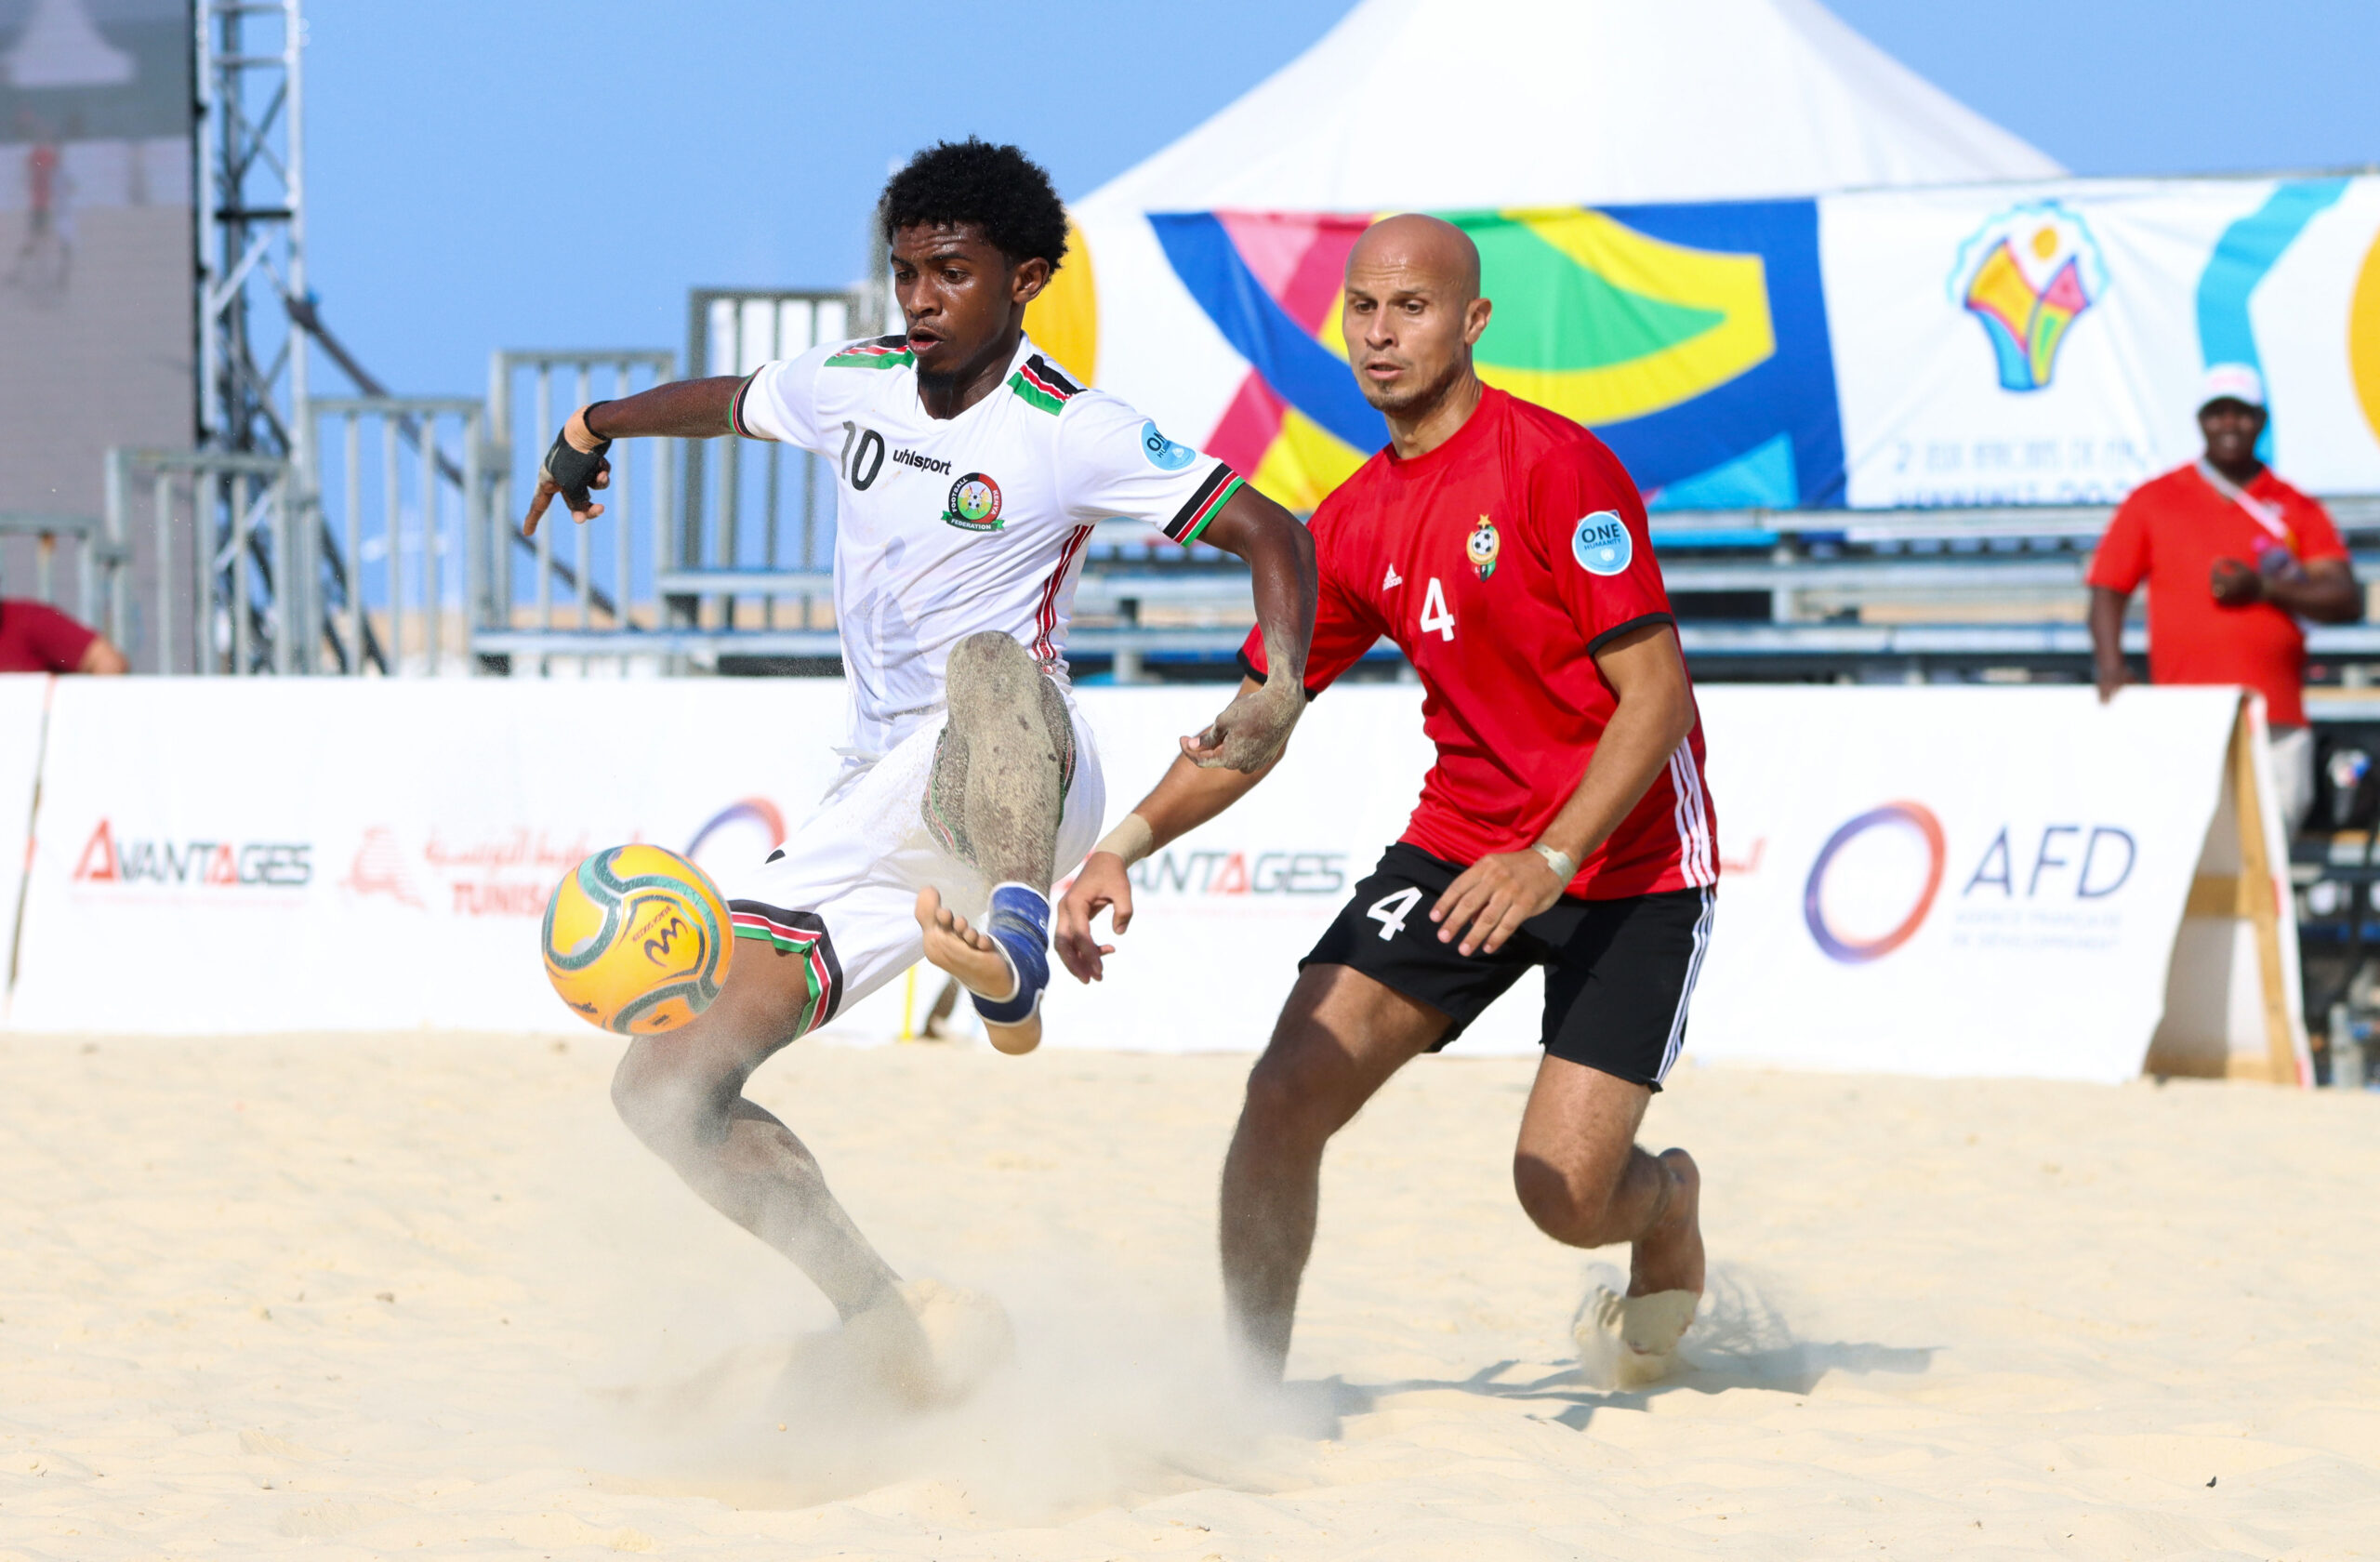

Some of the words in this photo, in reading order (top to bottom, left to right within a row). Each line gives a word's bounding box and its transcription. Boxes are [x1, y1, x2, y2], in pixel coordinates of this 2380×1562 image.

[840, 420, 885, 491] 10
[1146, 430, 1168, 452] ON
[892, 449, 952, 475] uhlsport
[951, 477, 969, 512] FOOTBALL
[990, 489, 1000, 516] KENYA
[950, 518, 992, 530] FEDERATION
[1581, 523, 1621, 543] ONE
[1583, 538, 1621, 551] HUMANITY
[1420, 576, 1456, 642] 4
[73, 818, 313, 886] AVANTAGES
[1060, 842, 1348, 894] ANTAGES
[1962, 824, 2138, 898] AFD
[1367, 886, 1423, 942] 4
